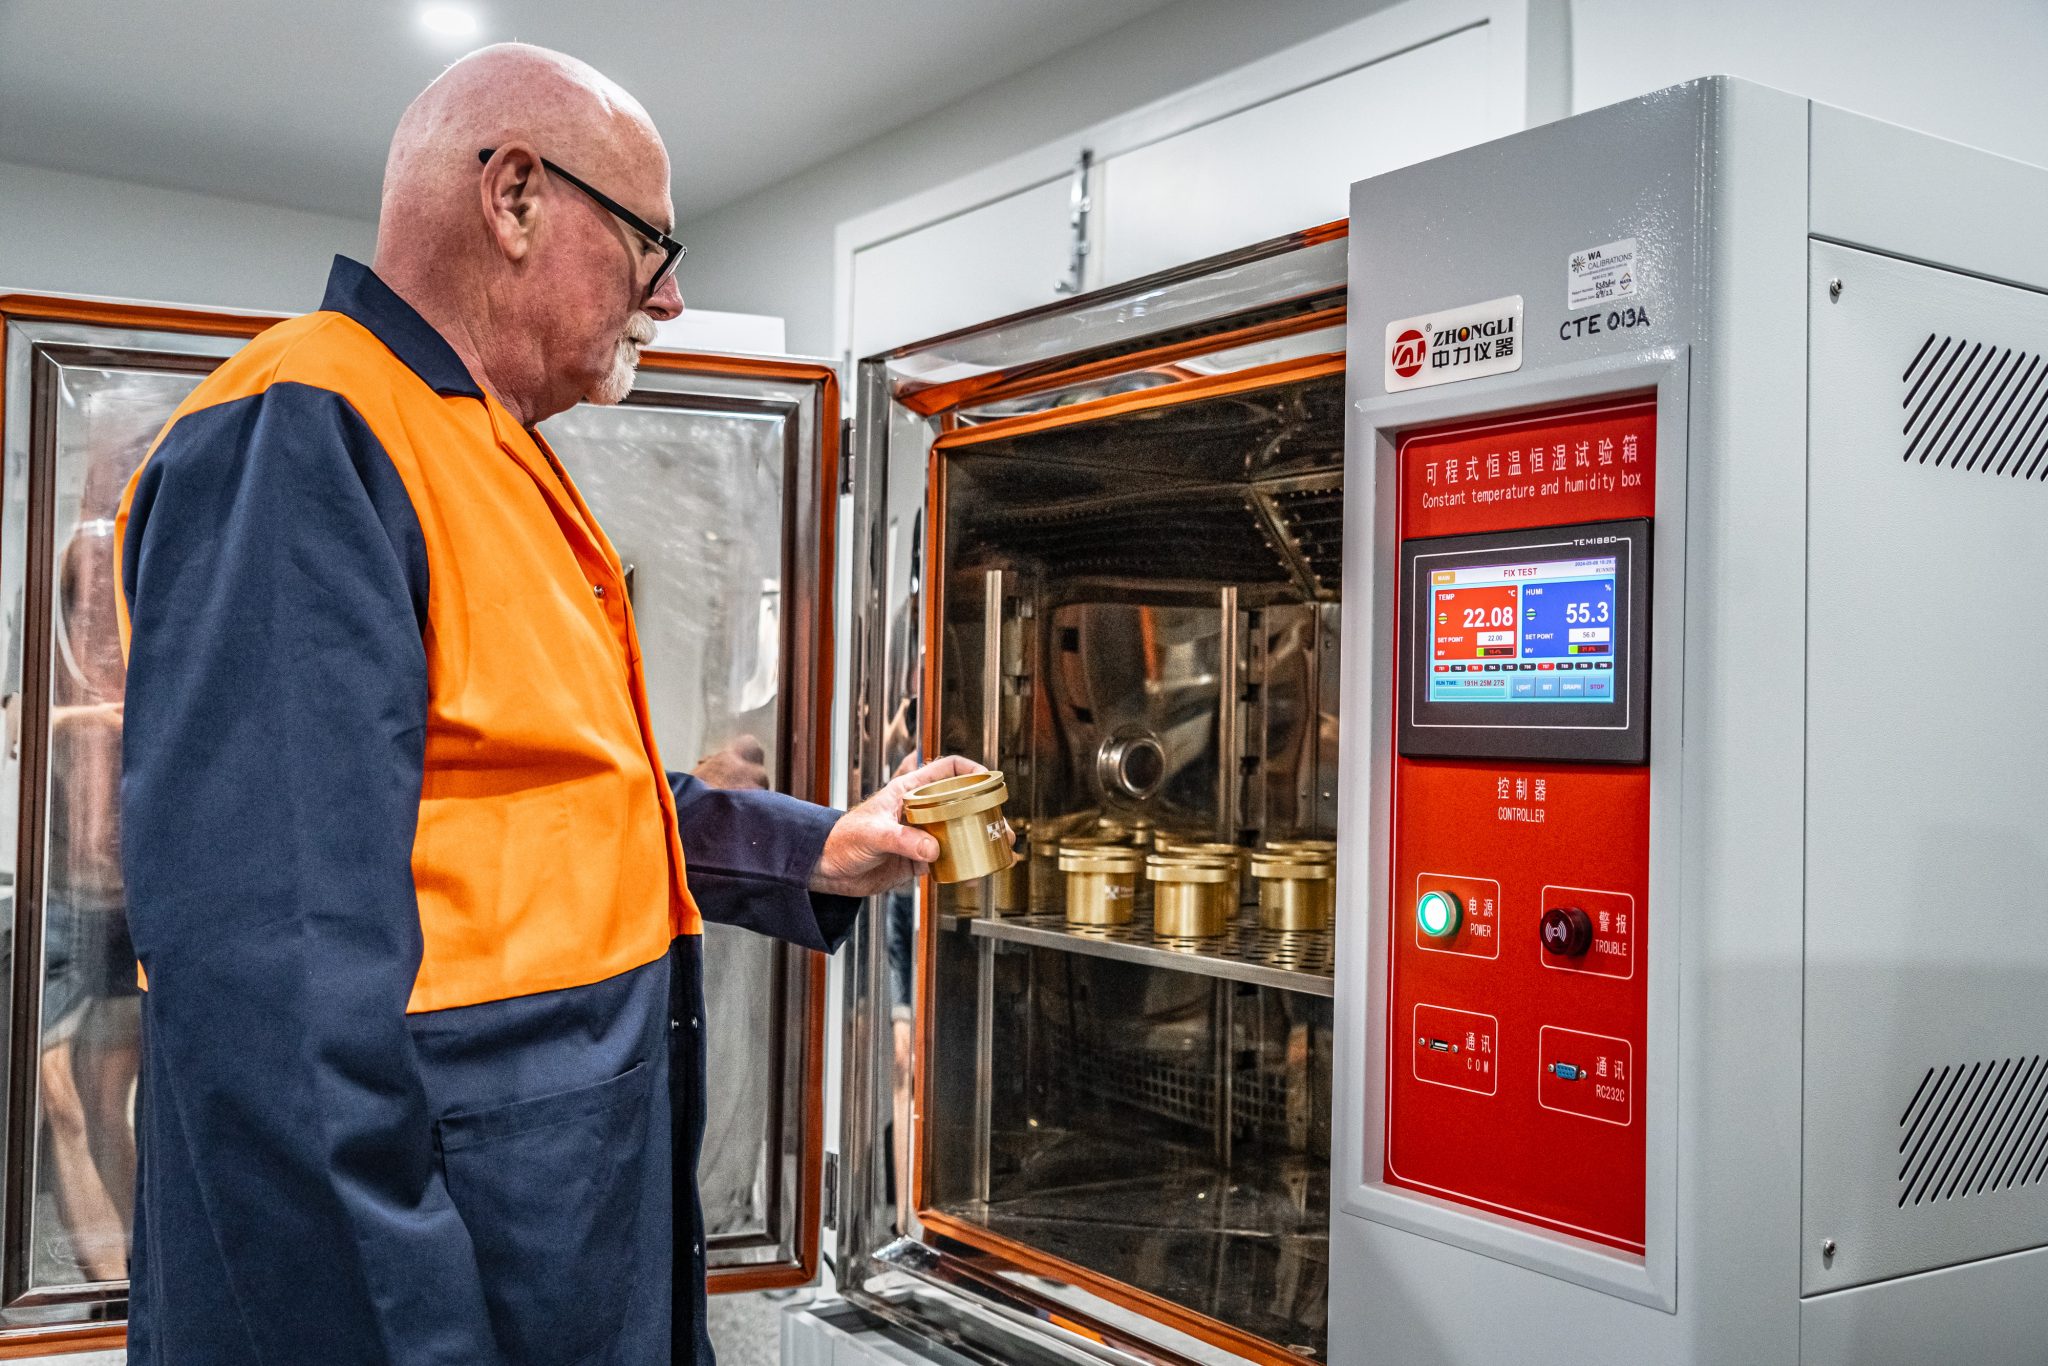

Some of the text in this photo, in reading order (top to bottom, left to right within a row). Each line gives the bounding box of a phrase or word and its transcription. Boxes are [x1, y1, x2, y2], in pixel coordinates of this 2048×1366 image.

[1587, 250, 1601, 261] WA
[1587, 252, 1633, 270] CALIBRATIONS
[1433, 317, 1514, 347] ZHONGLI
[1560, 306, 1651, 341] CTE 013A
[1432, 337, 1514, 368] 中力仪器
[1426, 434, 1638, 487] 可程式恒温恒湿试验箱
[1422, 470, 1642, 509] Constant temperature and humidity box
[1573, 536, 1617, 546] TEMI880
[1503, 568, 1537, 577] FIX TEST
[1525, 588, 1543, 596] HUMI
[1604, 583, 1612, 591] %
[1463, 606, 1514, 628] 22.08
[1566, 601, 1609, 624] 55.3
[1497, 777, 1546, 801] 控制器
[1498, 807, 1545, 823] CONTROLLER
[1468, 896, 1494, 917] 电源
[1470, 923, 1491, 937] POWER
[1599, 911, 1627, 935] 警报
[1595, 939, 1627, 956] TROUBLE
[1465, 1032, 1491, 1054] 通讯
[1596, 1056, 1625, 1080] 通讯
[1596, 1084, 1625, 1102] RC232C
